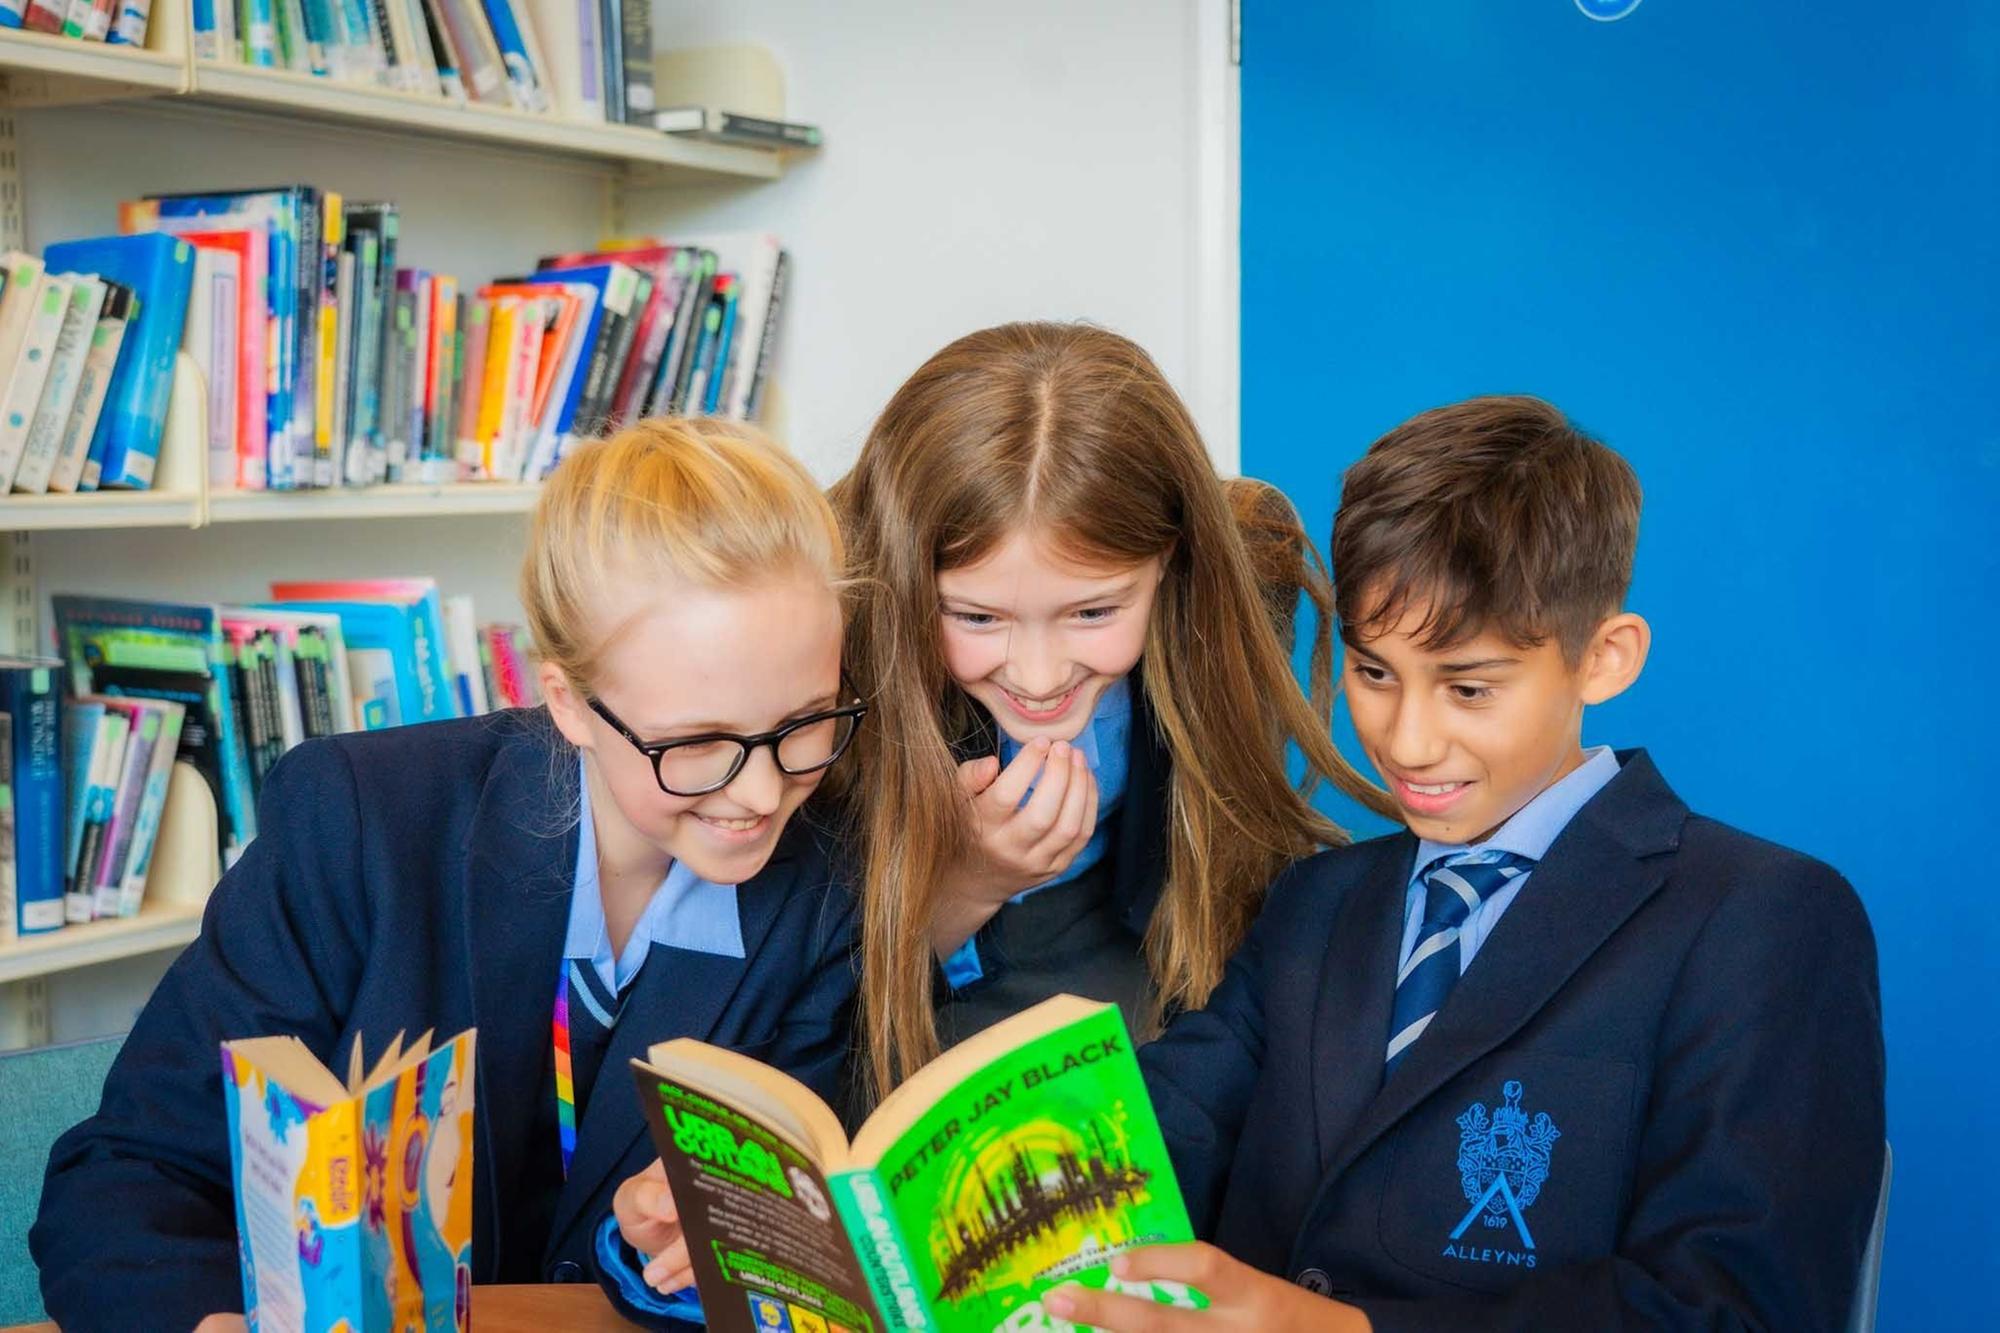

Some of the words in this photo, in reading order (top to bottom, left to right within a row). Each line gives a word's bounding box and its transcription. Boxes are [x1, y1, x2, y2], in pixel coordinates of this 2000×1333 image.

[888, 1118, 961, 1194] PETER
[967, 1081, 1016, 1124] JAY
[1021, 1034, 1124, 1089] BLACK
[1483, 1214, 1508, 1229] 1619
[1442, 1243, 1537, 1268] ALLEYN'S
